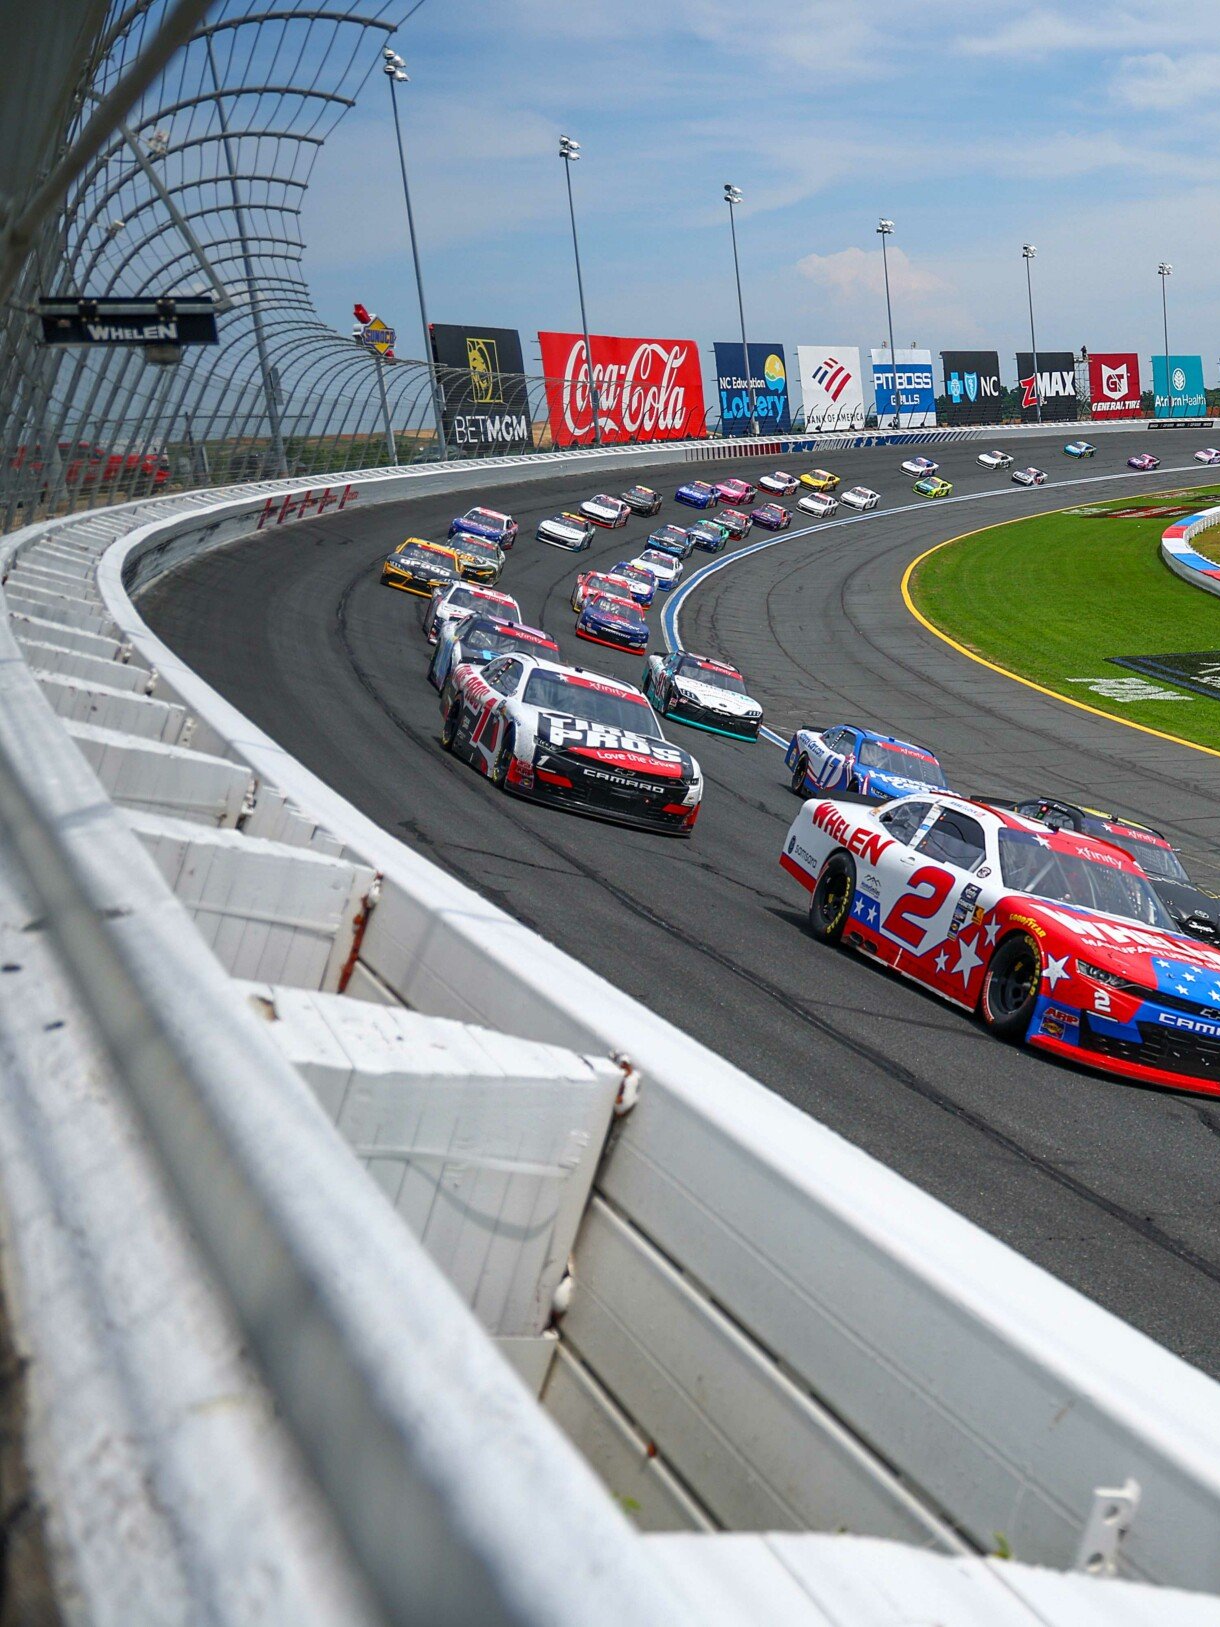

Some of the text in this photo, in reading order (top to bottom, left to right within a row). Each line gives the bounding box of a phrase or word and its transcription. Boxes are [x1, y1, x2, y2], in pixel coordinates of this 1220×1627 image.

[87, 323, 178, 340] WHELEN
[563, 339, 688, 436] Coca-Cola
[719, 377, 732, 389] NC
[874, 373, 932, 389] PIT BOSS
[980, 376, 999, 396] NC
[890, 394, 920, 405] GILLS
[1092, 400, 1141, 412] GENERAL TIRE
[1183, 393, 1206, 405] Health
[827, 414, 836, 422] OF
[836, 413, 864, 422] AMERICA
[454, 414, 528, 445] BETMGM
[515, 631, 543, 643] xfinity
[589, 682, 628, 698] xfinity
[468, 697, 498, 748] 1
[549, 725, 682, 762] PROS
[535, 755, 550, 765] 1
[596, 751, 626, 761] Love
[627, 753, 647, 763] the
[900, 748, 925, 760] xfinity
[816, 754, 842, 789] 17
[583, 768, 665, 793] CAMARO
[812, 801, 896, 867] WHELEN
[1128, 829, 1157, 844] xfinity
[1075, 846, 1122, 869] xfinity
[881, 865, 956, 949] 2
[1009, 913, 1047, 938] GOODYEAR
[1094, 989, 1111, 1012] 2
[1045, 1007, 1079, 1025] ARP
